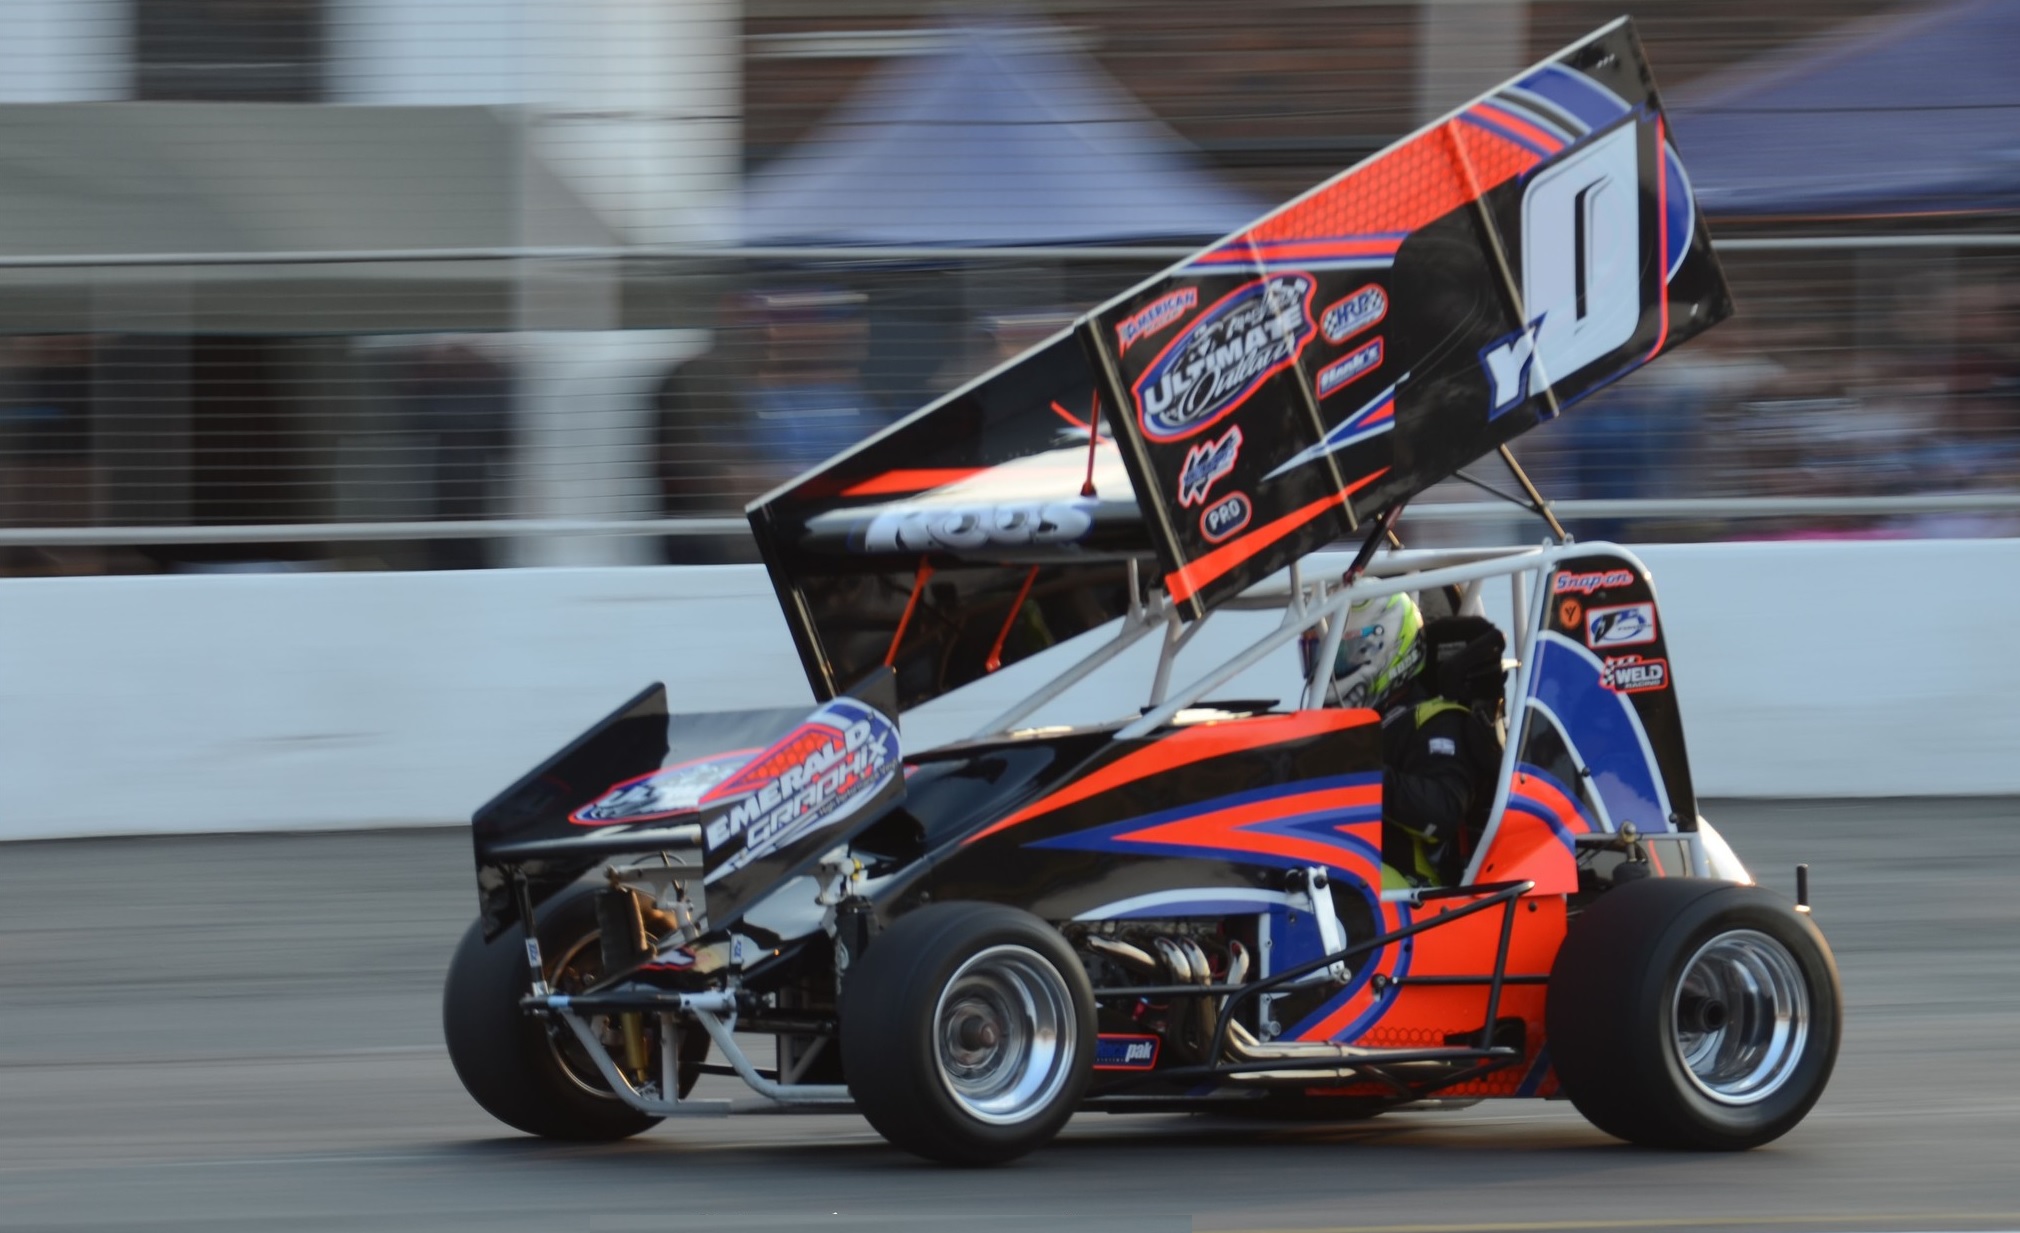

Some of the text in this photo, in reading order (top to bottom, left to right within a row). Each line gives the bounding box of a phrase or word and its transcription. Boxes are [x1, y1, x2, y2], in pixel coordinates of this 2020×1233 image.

[1144, 303, 1304, 414] ULTIMATE
[1208, 501, 1243, 530] PRO
[1557, 572, 1630, 590] Snap-on
[1615, 664, 1663, 684] WELD
[706, 719, 872, 850] EMERALD
[747, 730, 888, 847] GRAPHIX
